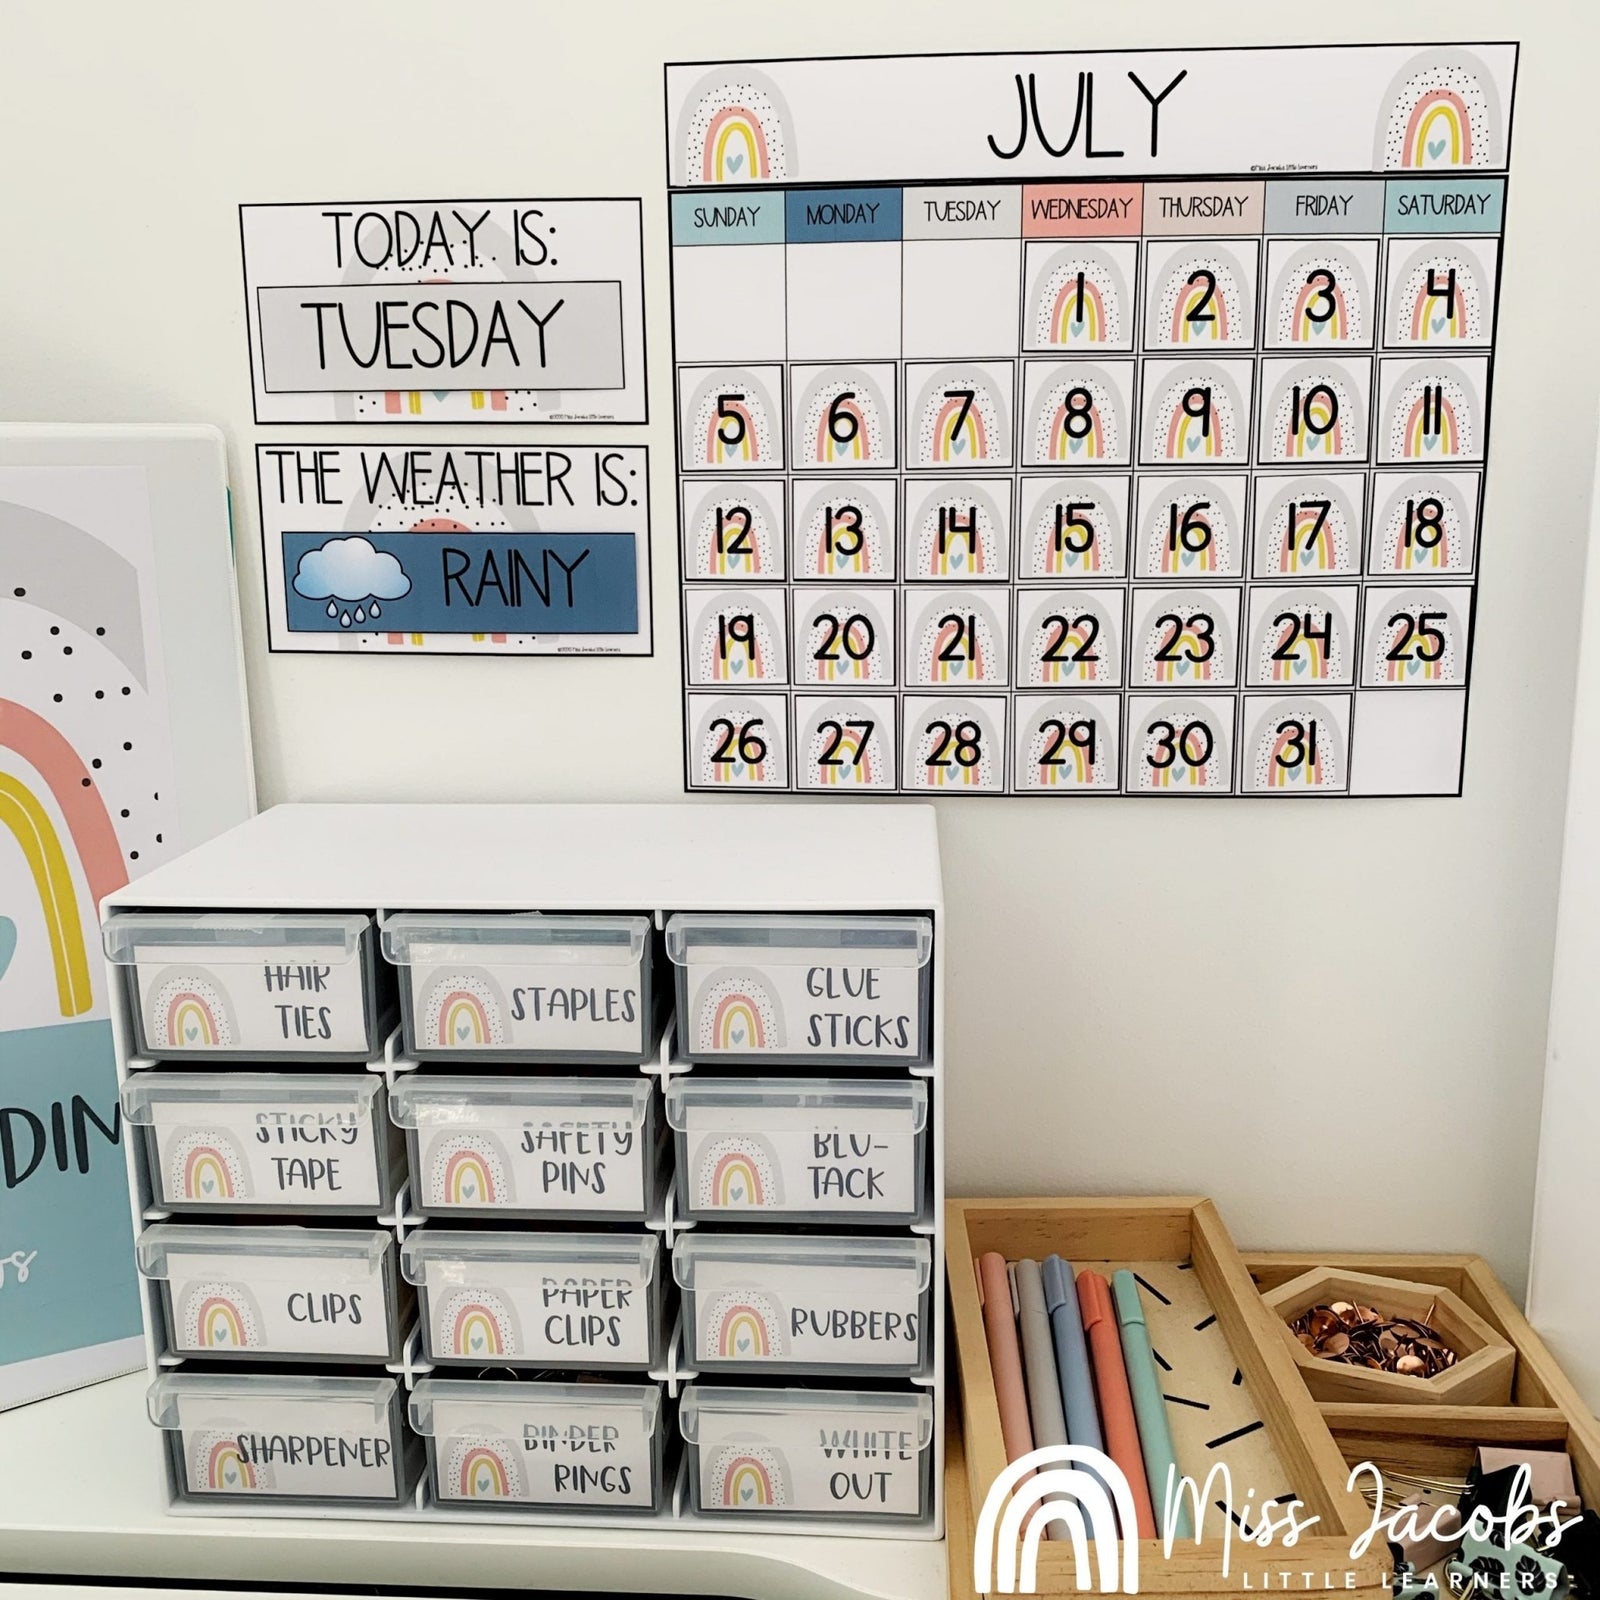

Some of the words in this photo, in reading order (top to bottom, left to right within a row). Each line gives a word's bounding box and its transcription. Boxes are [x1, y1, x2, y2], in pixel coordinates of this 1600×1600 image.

[986, 70, 1188, 159] JULY
[694, 206, 761, 228] SUNDAY
[806, 203, 880, 224] MONDAY
[924, 200, 1001, 222] TUESDAY
[1032, 197, 1133, 220] WEDNESDAY
[1159, 196, 1249, 217] THURSDAY
[1296, 195, 1353, 216] FRIDAY
[1398, 194, 1491, 215] SATURDAY
[322, 210, 490, 268] TODAY
[513, 209, 558, 266] IS:
[1076, 272, 1084, 323] 1
[1186, 270, 1216, 321] 2
[1305, 270, 1336, 322] 3
[1426, 268, 1456, 319] 4
[301, 299, 564, 370] TUESDAY
[717, 394, 745, 445] 5
[828, 392, 859, 443] 6
[944, 390, 975, 441] 7
[1064, 387, 1092, 439] 8
[1182, 387, 1212, 437] 9
[1292, 384, 1338, 435] 10
[1423, 385, 1442, 435] 11
[266, 451, 343, 504] THE
[361, 452, 575, 506] WEATHER
[595, 453, 638, 507] IS:
[716, 507, 753, 554] 12
[825, 506, 863, 555] 13
[938, 507, 976, 554] 14
[1053, 502, 1096, 552] 15
[1170, 502, 1212, 552] 16
[1287, 501, 1331, 551] 17
[1405, 498, 1444, 548] 18
[442, 548, 590, 608] RAINY
[718, 615, 754, 660] 19
[814, 614, 875, 660] 20
[938, 615, 975, 661] 21
[1041, 614, 1100, 661] 22
[1155, 614, 1215, 662] 23
[1272, 612, 1332, 660] 24
[1386, 613, 1447, 661] 25
[709, 719, 767, 764] 26
[817, 721, 874, 766] 27
[925, 721, 982, 766] 28
[1038, 719, 1096, 766] 29
[1147, 721, 1213, 768] 30
[1275, 719, 1316, 768] 31
[807, 967, 881, 999] GLUE
[511, 987, 636, 1023] STAPLES
[275, 1005, 332, 1040] TIES
[807, 1013, 910, 1049] STICKS
[256, 1111, 358, 1145] STICKY
[271, 1157, 342, 1191] TAPE
[542, 1161, 606, 1194] PINS
[807, 1167, 884, 1200] TACK
[287, 1293, 362, 1324] CLIPS
[542, 1278, 632, 1309] PAPER
[545, 1315, 621, 1346] CLIPS
[791, 1308, 918, 1341] RUBBERS
[236, 1434, 391, 1467] SHARPENER
[555, 1464, 632, 1495] RINGS
[830, 1472, 892, 1503] OUT
